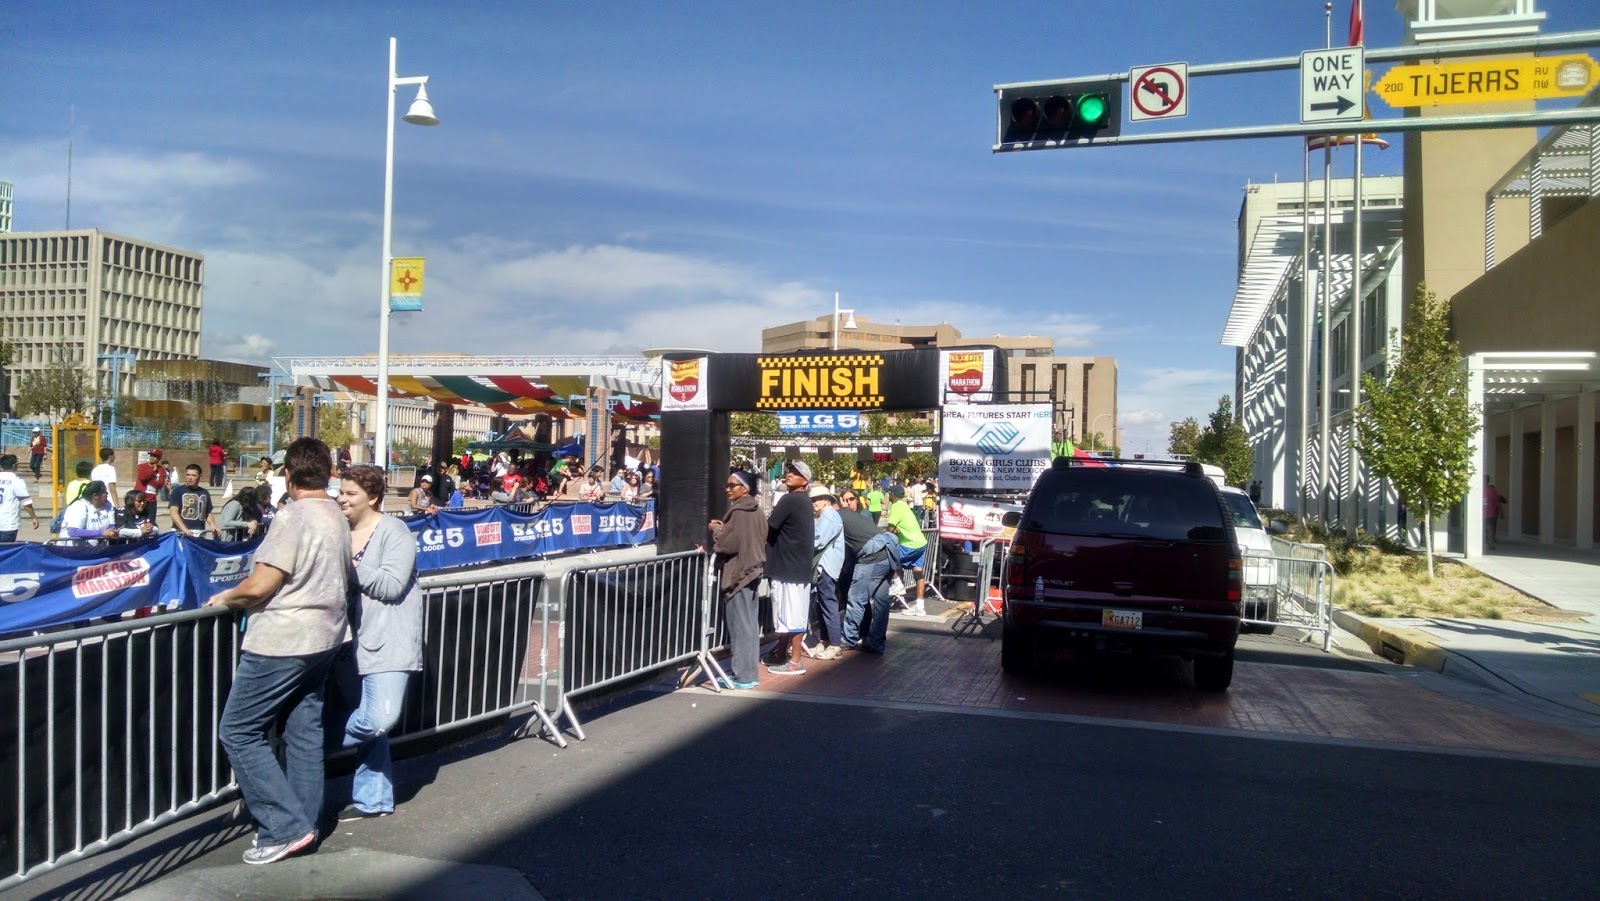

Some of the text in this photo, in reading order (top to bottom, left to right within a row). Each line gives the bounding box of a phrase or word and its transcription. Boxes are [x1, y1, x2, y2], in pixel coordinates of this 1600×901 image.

[1312, 54, 1353, 73] ONE
[1534, 66, 1549, 76] AV
[1313, 73, 1355, 92] WAY
[1384, 68, 1520, 97] 200 TIJERAS
[1533, 79, 1549, 89] NW
[761, 367, 879, 397] FINISH
[950, 378, 981, 387] MARATHON
[778, 414, 859, 429] BIG 5
[967, 411, 1005, 419] FUTURES
[1006, 411, 1032, 419] START
[1033, 410, 1053, 418] HERE
[949, 458, 1046, 467] BOYS & GIRLS CLUBS
[961, 466, 995, 474] CENTRAL
[1016, 467, 1045, 475] MEXICO
[180, 492, 208, 521] 81
[552, 518, 564, 535] 5
[625, 515, 637, 531] 5
[446, 527, 465, 548] 5
[423, 544, 445, 552] GOODS
[76, 559, 144, 581] DUKE CITY
[209, 571, 253, 584] SPORTIN
[0, 572, 41, 603] 5
[76, 569, 146, 596] MARATHON
[1032, 578, 1075, 587] CEVROLET
[1109, 615, 1141, 627] KGA712
